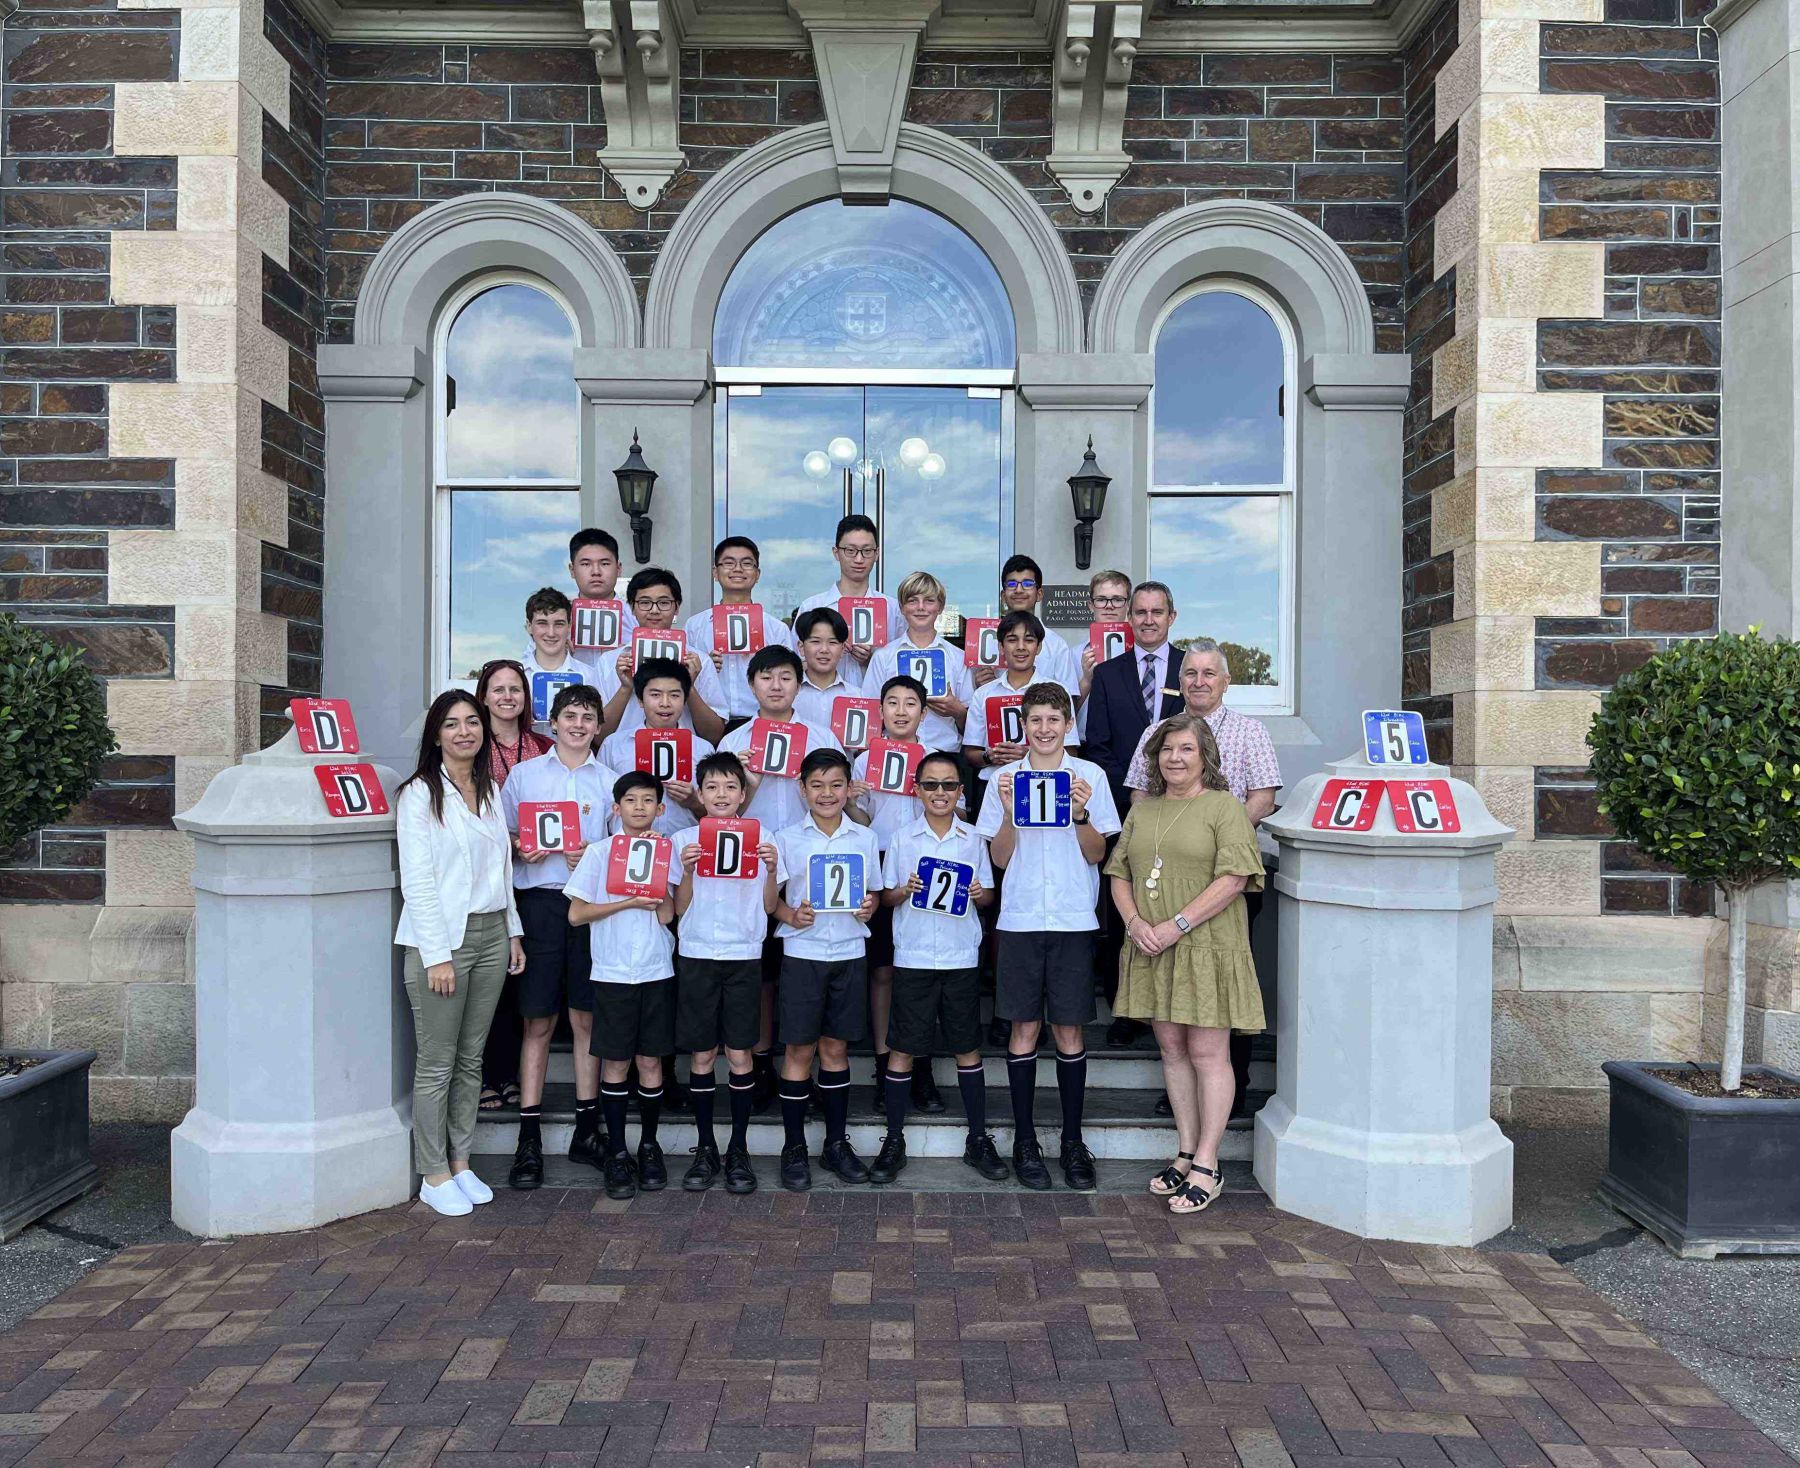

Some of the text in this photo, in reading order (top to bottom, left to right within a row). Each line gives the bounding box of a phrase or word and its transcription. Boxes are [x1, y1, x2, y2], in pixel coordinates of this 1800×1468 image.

[1054, 590, 1091, 598] HEADMA
[577, 609, 617, 645] HD
[729, 615, 748, 651] D
[854, 608, 871, 643] D
[980, 628, 998, 664] C
[313, 711, 340, 750] D
[845, 709, 866, 746] D
[1003, 707, 1024, 744] D
[1386, 722, 1405, 762] 5
[654, 741, 674, 781] D
[764, 732, 788, 772] D
[882, 751, 905, 790] D
[337, 775, 368, 813] D
[1036, 779, 1046, 822] 1
[1333, 790, 1363, 826] C
[1411, 791, 1439, 829] C
[539, 812, 561, 848] C
[628, 839, 653, 883] C
[716, 831, 740, 875] D
[830, 864, 845, 907] 2
[931, 871, 952, 912] 2
